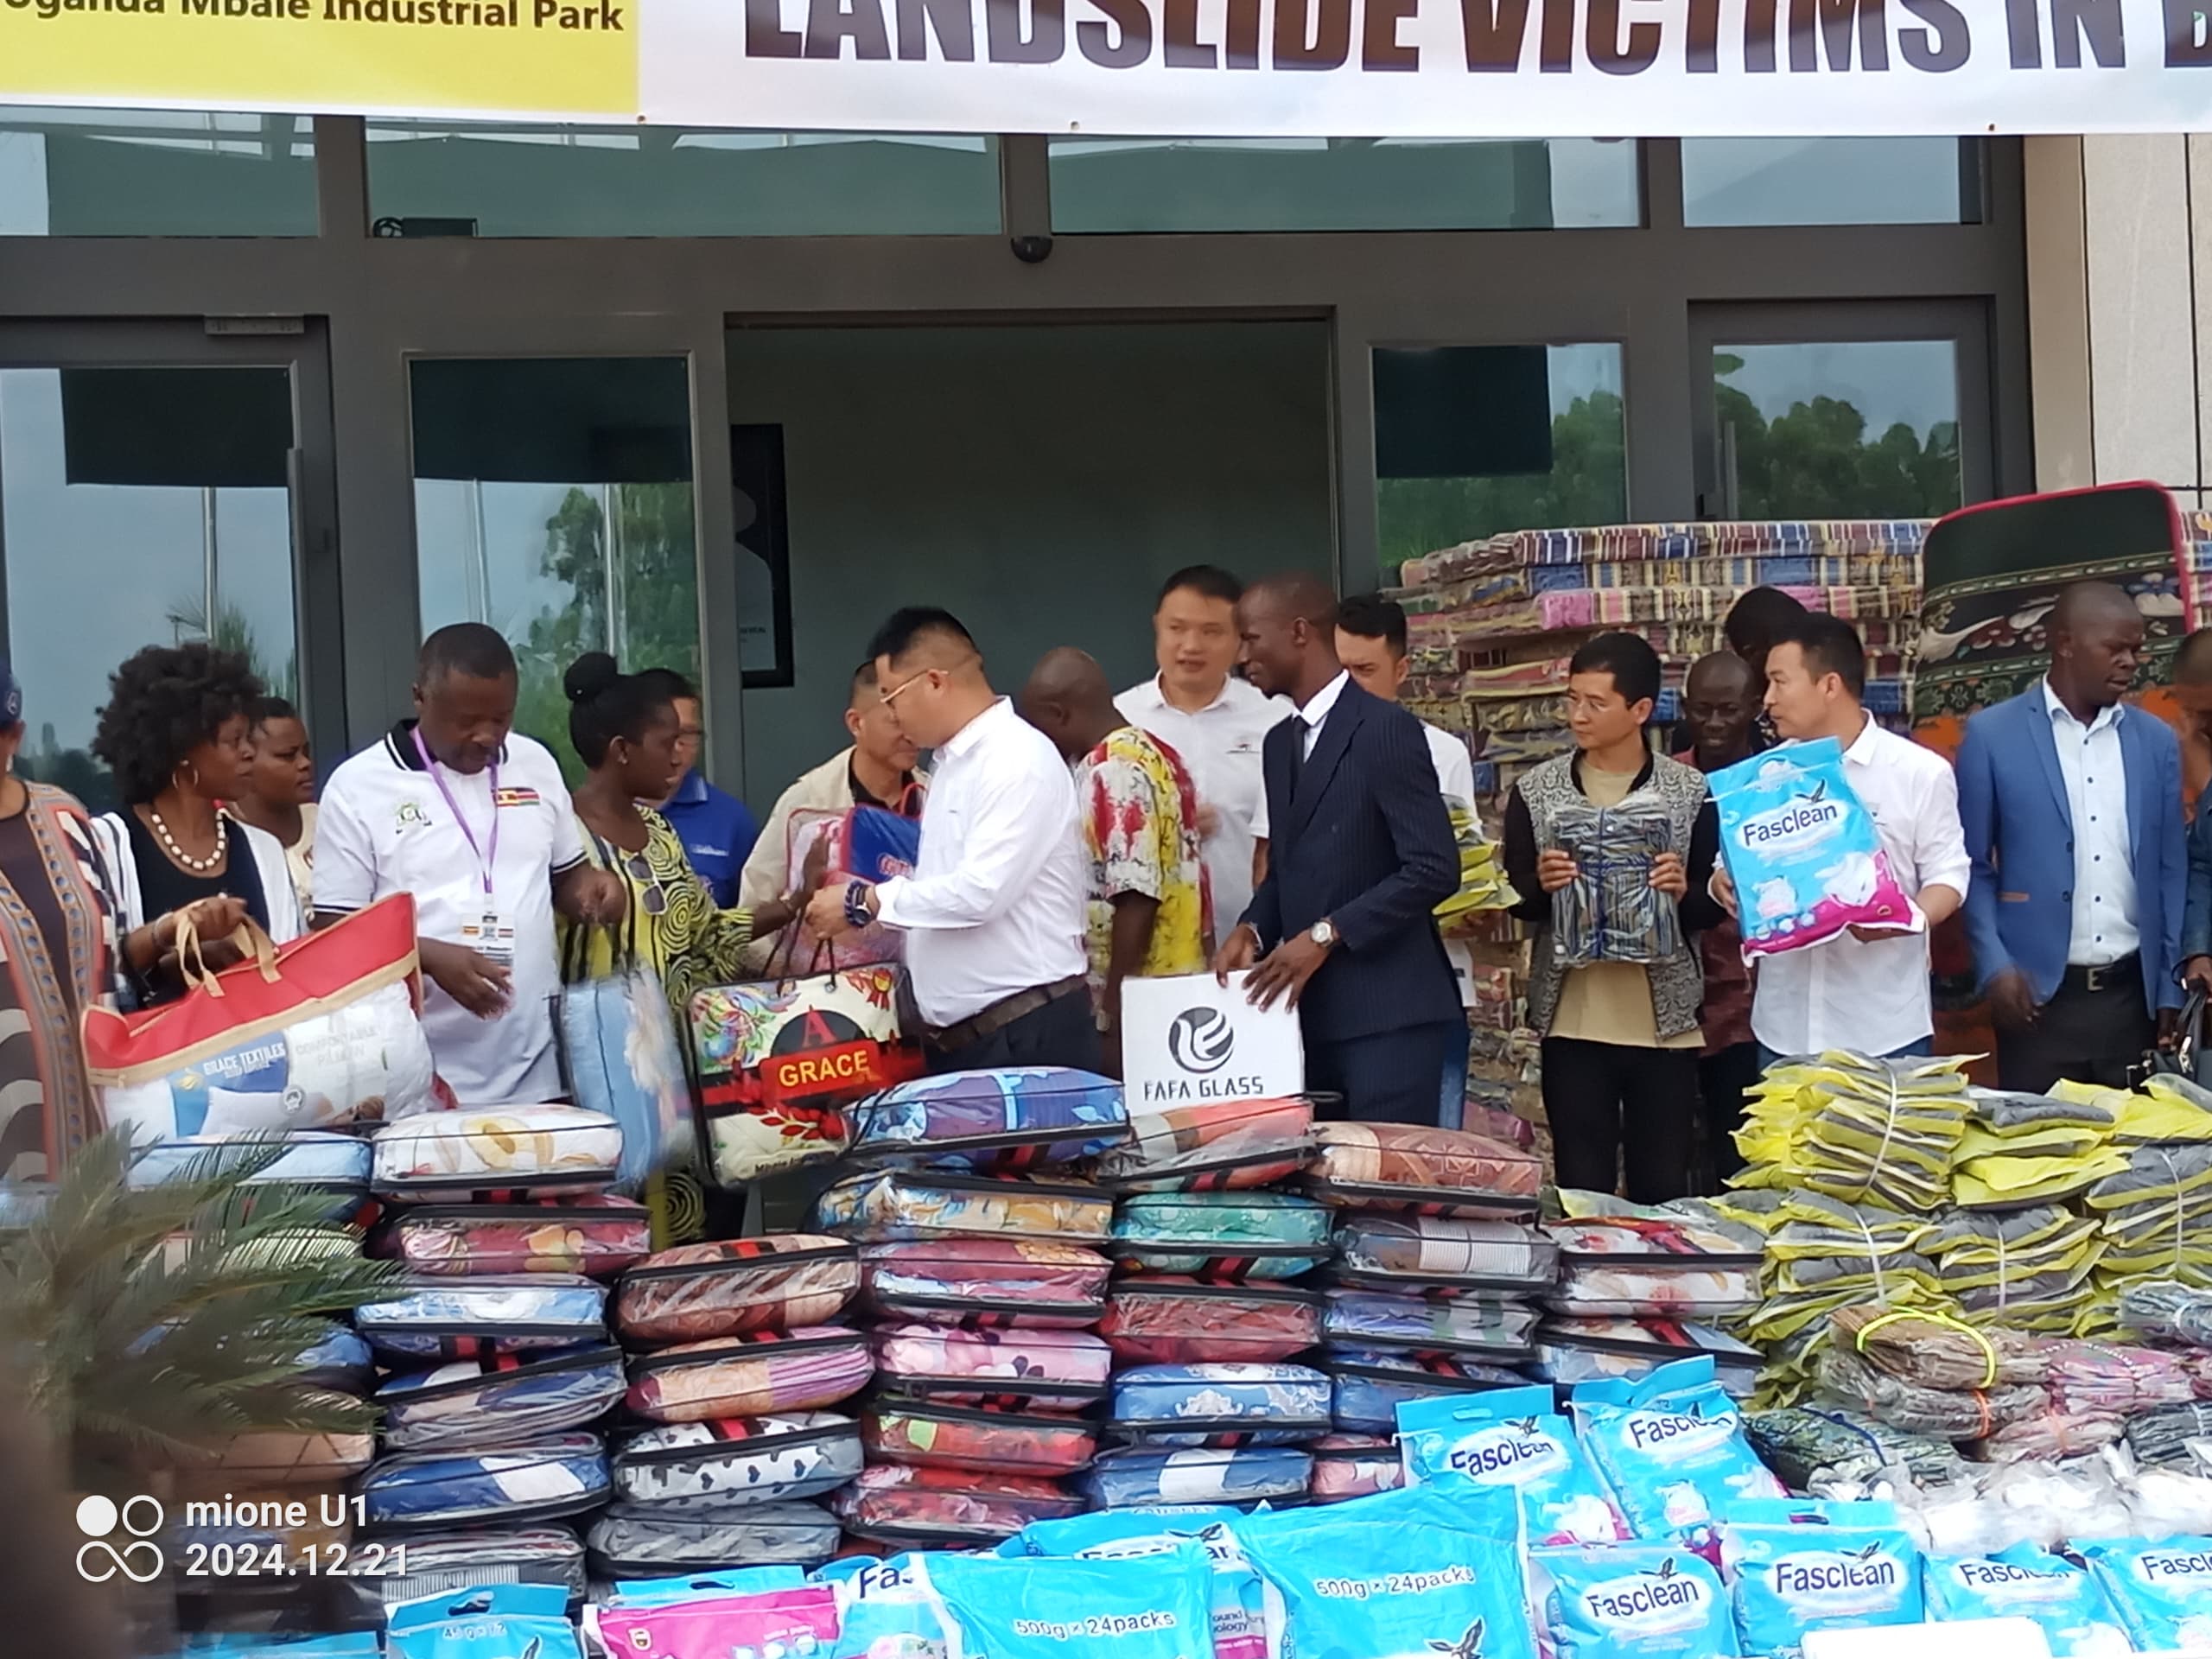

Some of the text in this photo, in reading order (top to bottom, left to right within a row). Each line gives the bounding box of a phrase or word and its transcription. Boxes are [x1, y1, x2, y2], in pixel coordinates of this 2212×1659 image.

[323, 0, 518, 27] Industrial
[533, 0, 624, 30] Park
[1743, 804, 1838, 846] Fasclean
[779, 1050, 868, 1087] GRACE
[1144, 1076, 1264, 1101] FAFA GLASS
[1629, 1416, 1732, 1448] Fasc
[1777, 1560, 1895, 1593] Fasclean
[1960, 1562, 2070, 1586] Fasc
[2140, 1553, 2212, 1580] Fascl
[1586, 1580, 1700, 1618] Fasclean
